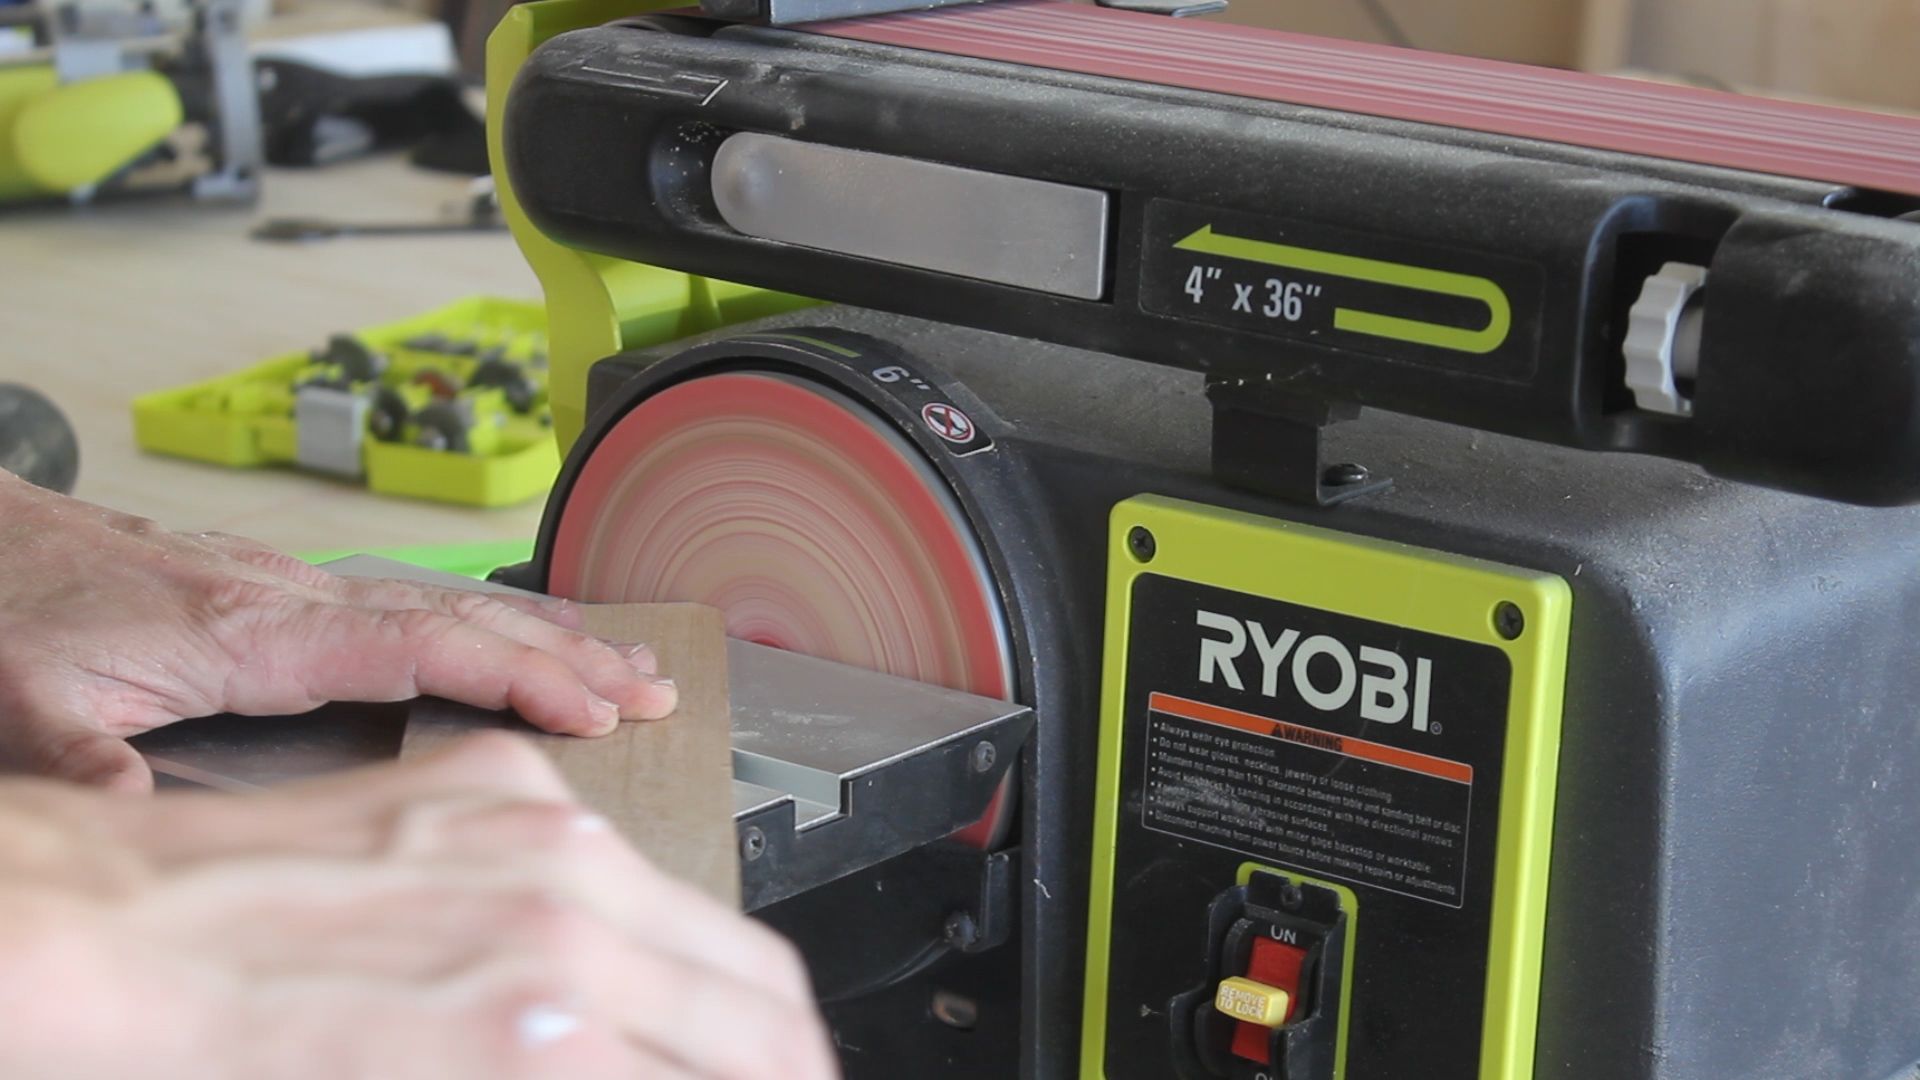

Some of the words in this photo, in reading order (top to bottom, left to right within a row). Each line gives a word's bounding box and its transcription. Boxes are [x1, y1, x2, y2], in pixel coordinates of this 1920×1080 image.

[1184, 265, 1222, 304] 4"
[1232, 283, 1253, 313] x
[1263, 278, 1322, 322] 36"
[872, 366, 931, 390] 6"
[1197, 610, 1432, 732] RYOBI
[1160, 722, 1190, 738] Always
[1191, 732, 1212, 742] wear
[1214, 737, 1230, 748] eye
[1283, 723, 1343, 752] WARNING
[1159, 737, 1171, 747] Do
[1173, 741, 1186, 751] not
[1188, 746, 1208, 756] wear
[1285, 767, 1317, 784] jewelry
[1319, 777, 1328, 785] or
[1330, 778, 1354, 791] loose
[1157, 766, 1181, 779] Avoid
[1224, 783, 1235, 794] by
[1237, 787, 1270, 803] sanding
[1272, 795, 1281, 804] in
[1283, 798, 1332, 817] accordance
[1334, 811, 1353, 822] with
[1355, 816, 1369, 826] the
[1371, 820, 1420, 839] directional
[1194, 762, 1204, 770] no
[1205, 765, 1224, 775] more
[1226, 768, 1245, 780] than
[1266, 778, 1305, 795] clearance
[1307, 788, 1341, 804] between
[1342, 796, 1362, 809] table
[1364, 802, 1379, 813] and
[1381, 806, 1413, 824] sanding
[1415, 814, 1431, 826] belt
[1433, 820, 1442, 829] or
[1155, 796, 1185, 812] Always
[1187, 804, 1219, 820] support
[1265, 824, 1283, 836] with
[1285, 829, 1309, 842] miter
[1334, 841, 1373, 859] backstop
[1375, 853, 1384, 861] or
[1155, 810, 1196, 828] Disconnect
[1198, 822, 1231, 837] machine
[1233, 830, 1251, 842] from
[1252, 837, 1277, 850] power
[1278, 843, 1304, 856] source
[1306, 849, 1331, 863] before
[1333, 857, 1363, 872] making
[1394, 873, 1403, 881] or
[1219, 984, 1266, 1006] REMOVE
[1219, 996, 1233, 1010] TO
[1235, 1001, 1265, 1018] LOCK
